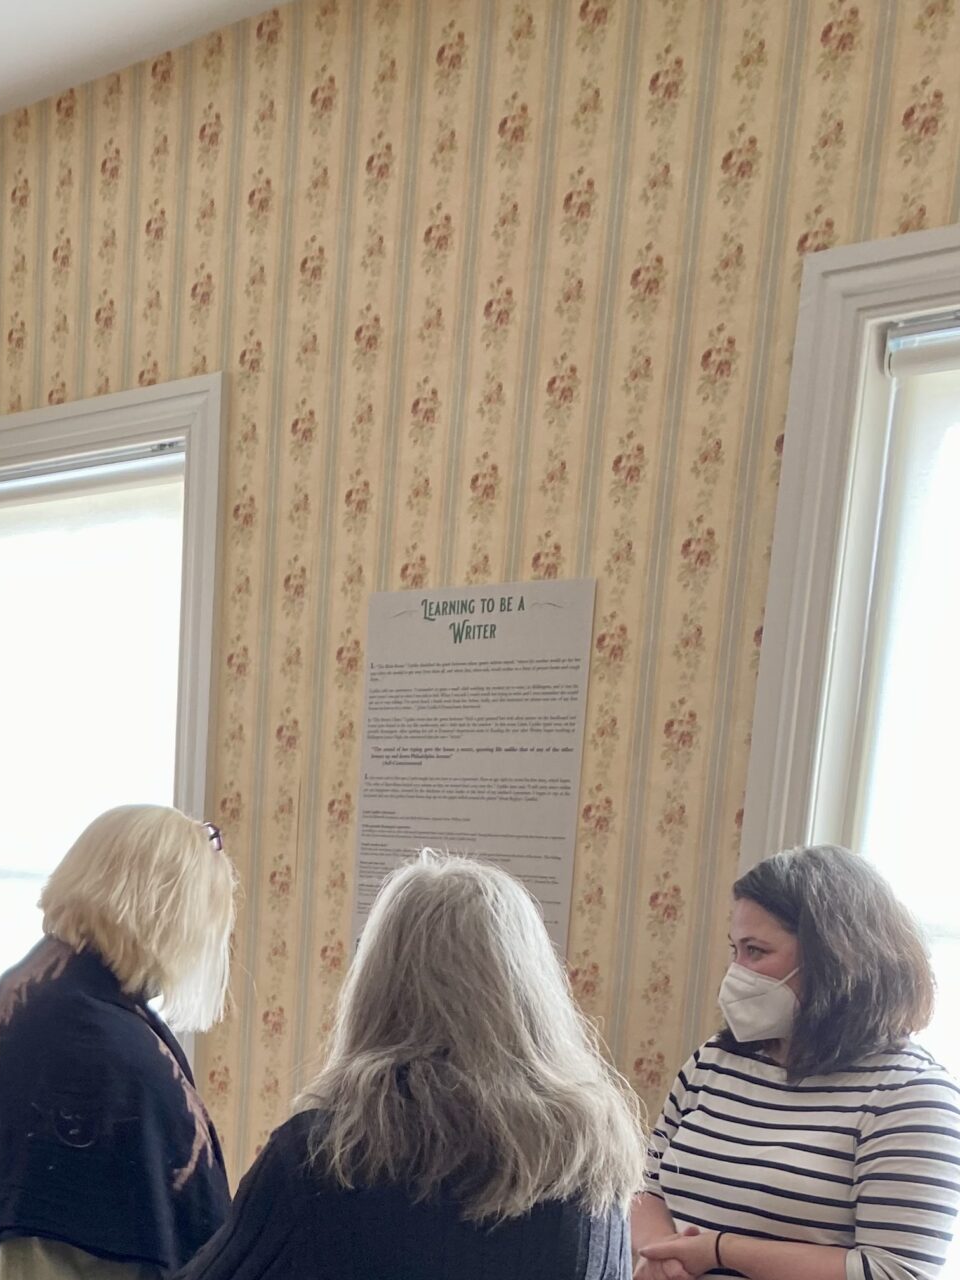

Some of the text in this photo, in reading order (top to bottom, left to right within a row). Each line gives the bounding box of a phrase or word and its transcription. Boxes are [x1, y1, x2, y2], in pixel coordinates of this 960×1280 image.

[421, 596, 525, 621] LEARNING TO BE A
[449, 619, 497, 644] WRITER
